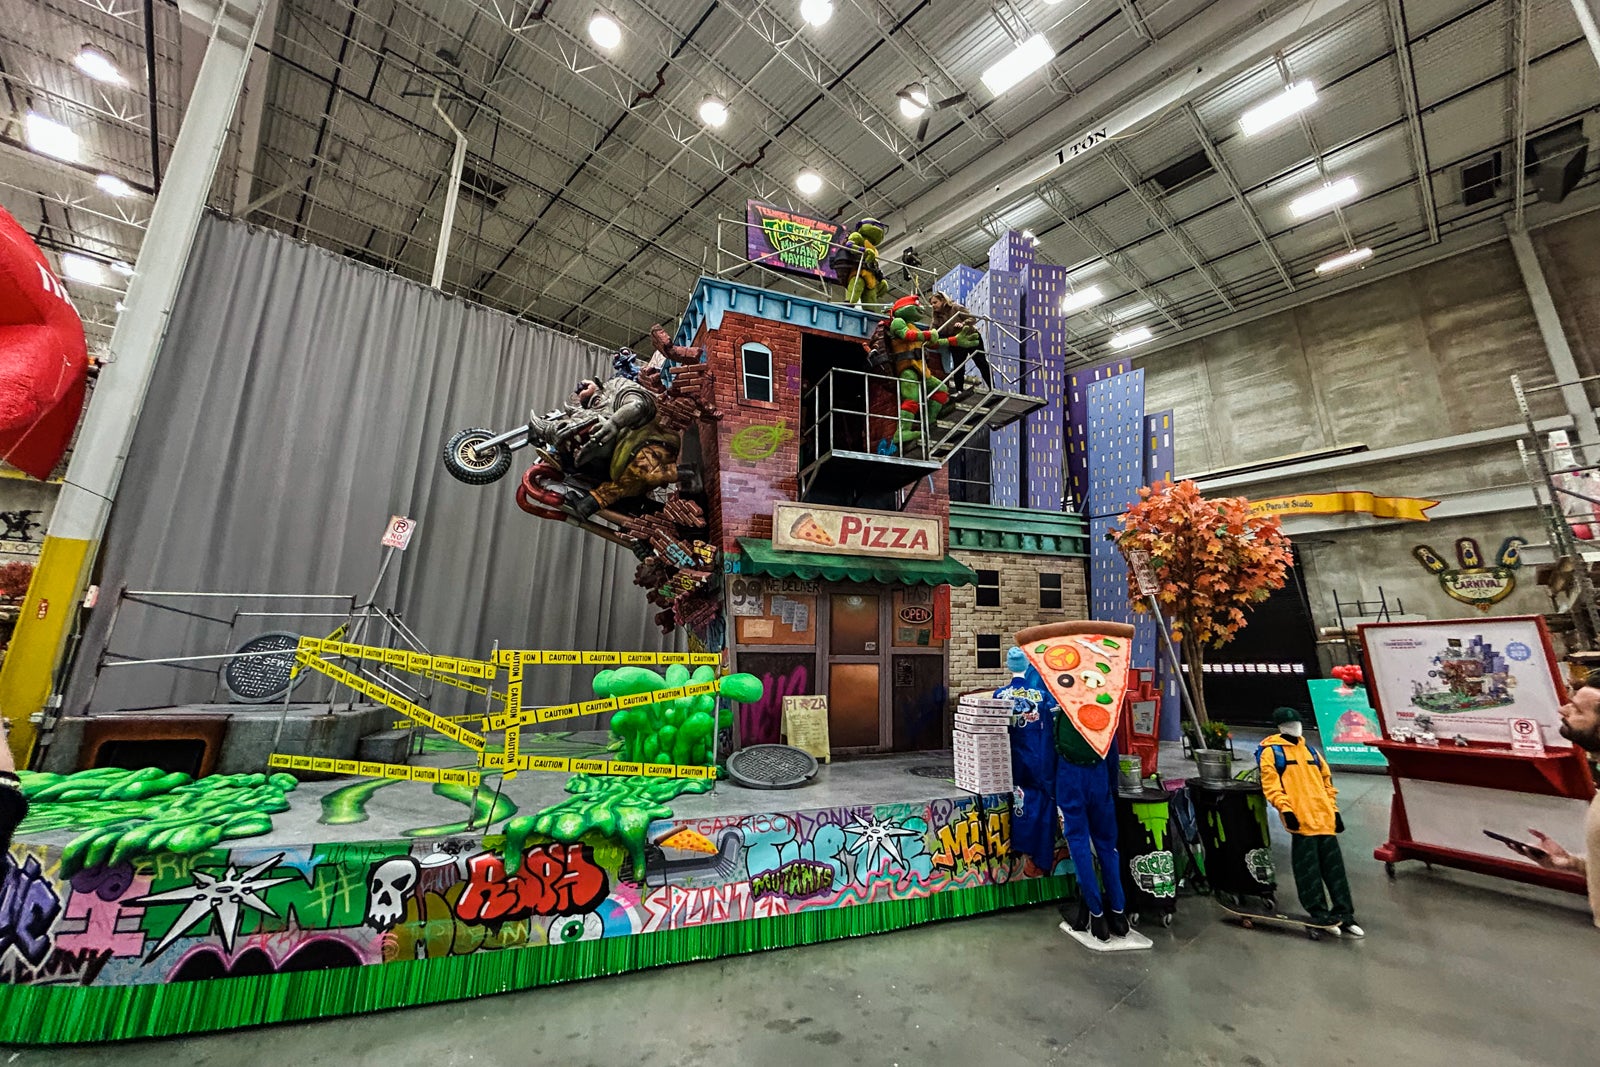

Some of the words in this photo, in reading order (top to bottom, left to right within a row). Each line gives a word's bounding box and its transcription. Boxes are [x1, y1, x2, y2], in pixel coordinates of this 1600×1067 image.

[1055, 149, 1064, 164] 1
[1069, 127, 1107, 155] TON
[1454, 579, 1503, 590] CARNIVAL
[903, 608, 928, 620] OPEN
[512, 651, 520, 677] AUTION
[510, 687, 519, 719] CAUTION
[544, 708, 573, 719] CAUTION
[586, 701, 613, 712] CAUTION
[624, 695, 648, 706] CAUTION
[657, 690, 681, 700] CAUTION
[689, 685, 710, 694] CAUTION
[508, 732, 517, 764] CAUTION
[534, 760, 563, 768] CAUTION
[575, 763, 602, 771] CAUTION
[613, 764, 638, 772] CAUTION
[648, 766, 672, 774] CAUTION
[680, 768, 703, 776] CAUTION
[697, 812, 800, 837] GARRISON
[751, 863, 833, 897] MUTANTS
